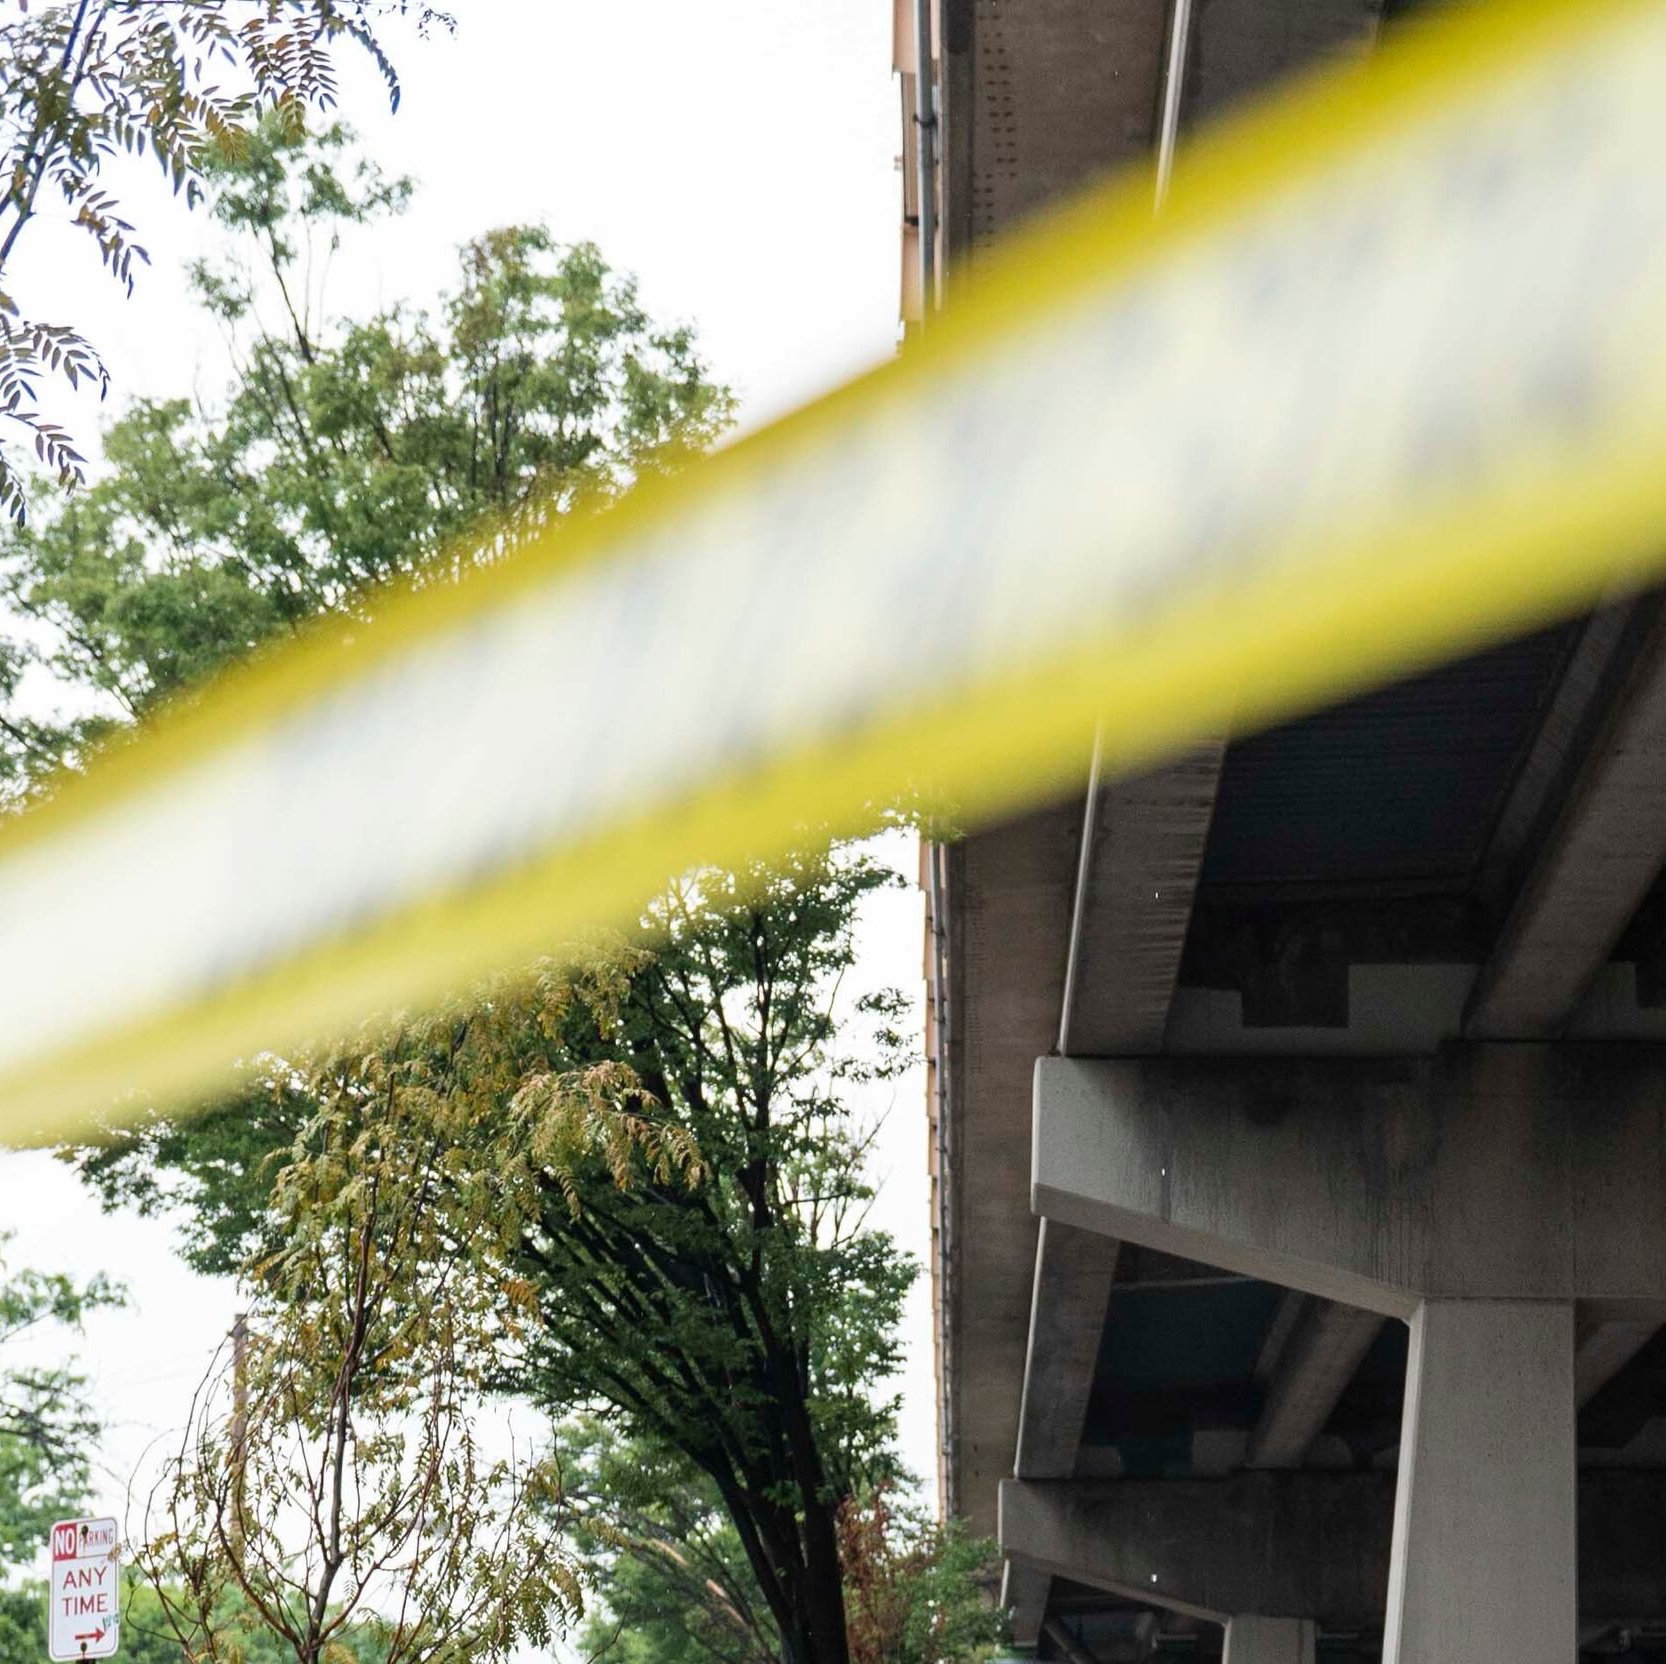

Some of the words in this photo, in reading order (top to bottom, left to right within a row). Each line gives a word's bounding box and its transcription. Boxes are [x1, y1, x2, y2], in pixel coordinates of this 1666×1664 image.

[55, 1528, 75, 1557] NO
[62, 1566, 108, 1590] ANY
[62, 1593, 108, 1616] TIME
